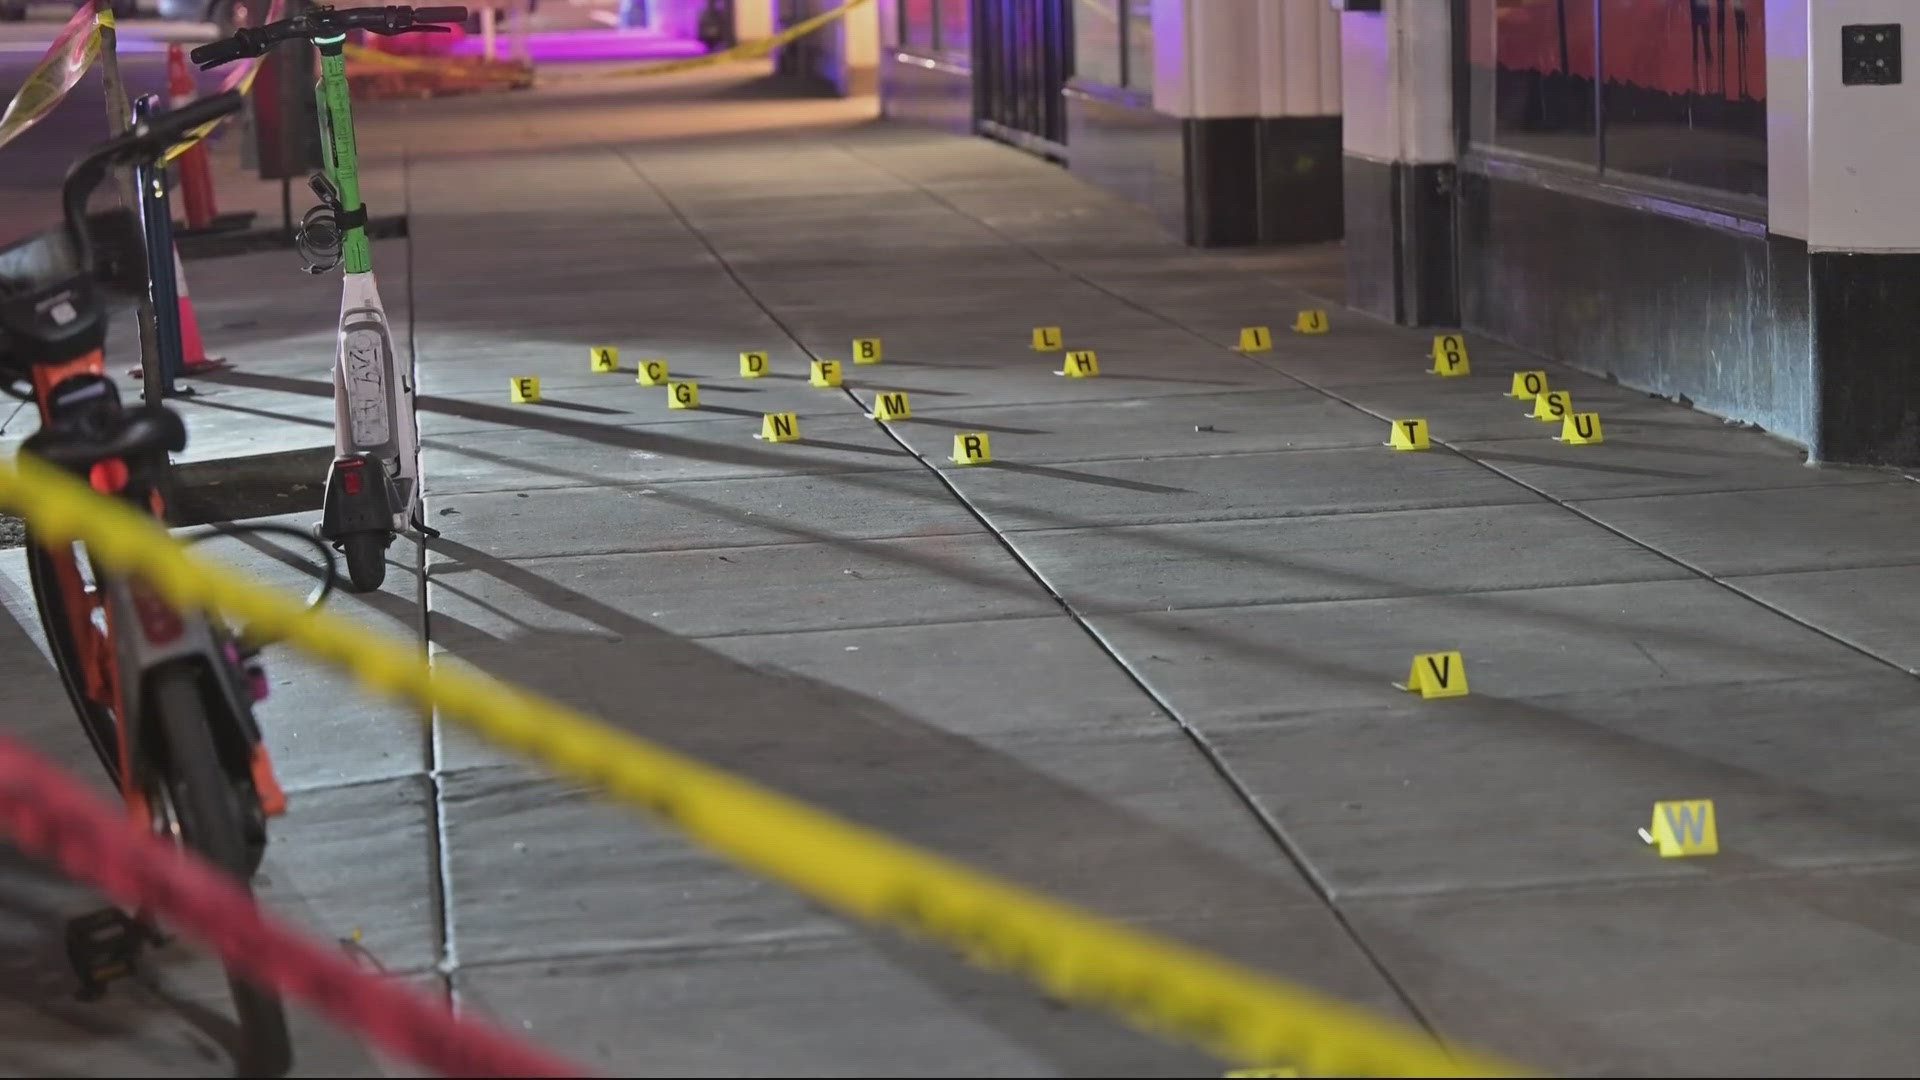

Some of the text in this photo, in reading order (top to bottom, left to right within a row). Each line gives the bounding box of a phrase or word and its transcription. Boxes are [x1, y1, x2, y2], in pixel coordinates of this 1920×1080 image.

[1309, 312, 1319, 329] J
[1042, 329, 1055, 347] L
[600, 349, 613, 367] A
[862, 340, 874, 359] B
[749, 354, 763, 372] D
[822, 362, 834, 380] F
[1075, 353, 1092, 372] H
[1447, 351, 1461, 371] P
[648, 362, 661, 381] C
[520, 379, 533, 399] E
[675, 384, 692, 404] G
[1525, 373, 1541, 395] O
[884, 394, 906, 415] M
[1547, 393, 1565, 417] S
[774, 414, 792, 437] N
[1402, 421, 1419, 445] T
[1574, 414, 1594, 439] U
[965, 435, 983, 459] R
[1427, 656, 1450, 689] V
[1665, 804, 1707, 847] W
